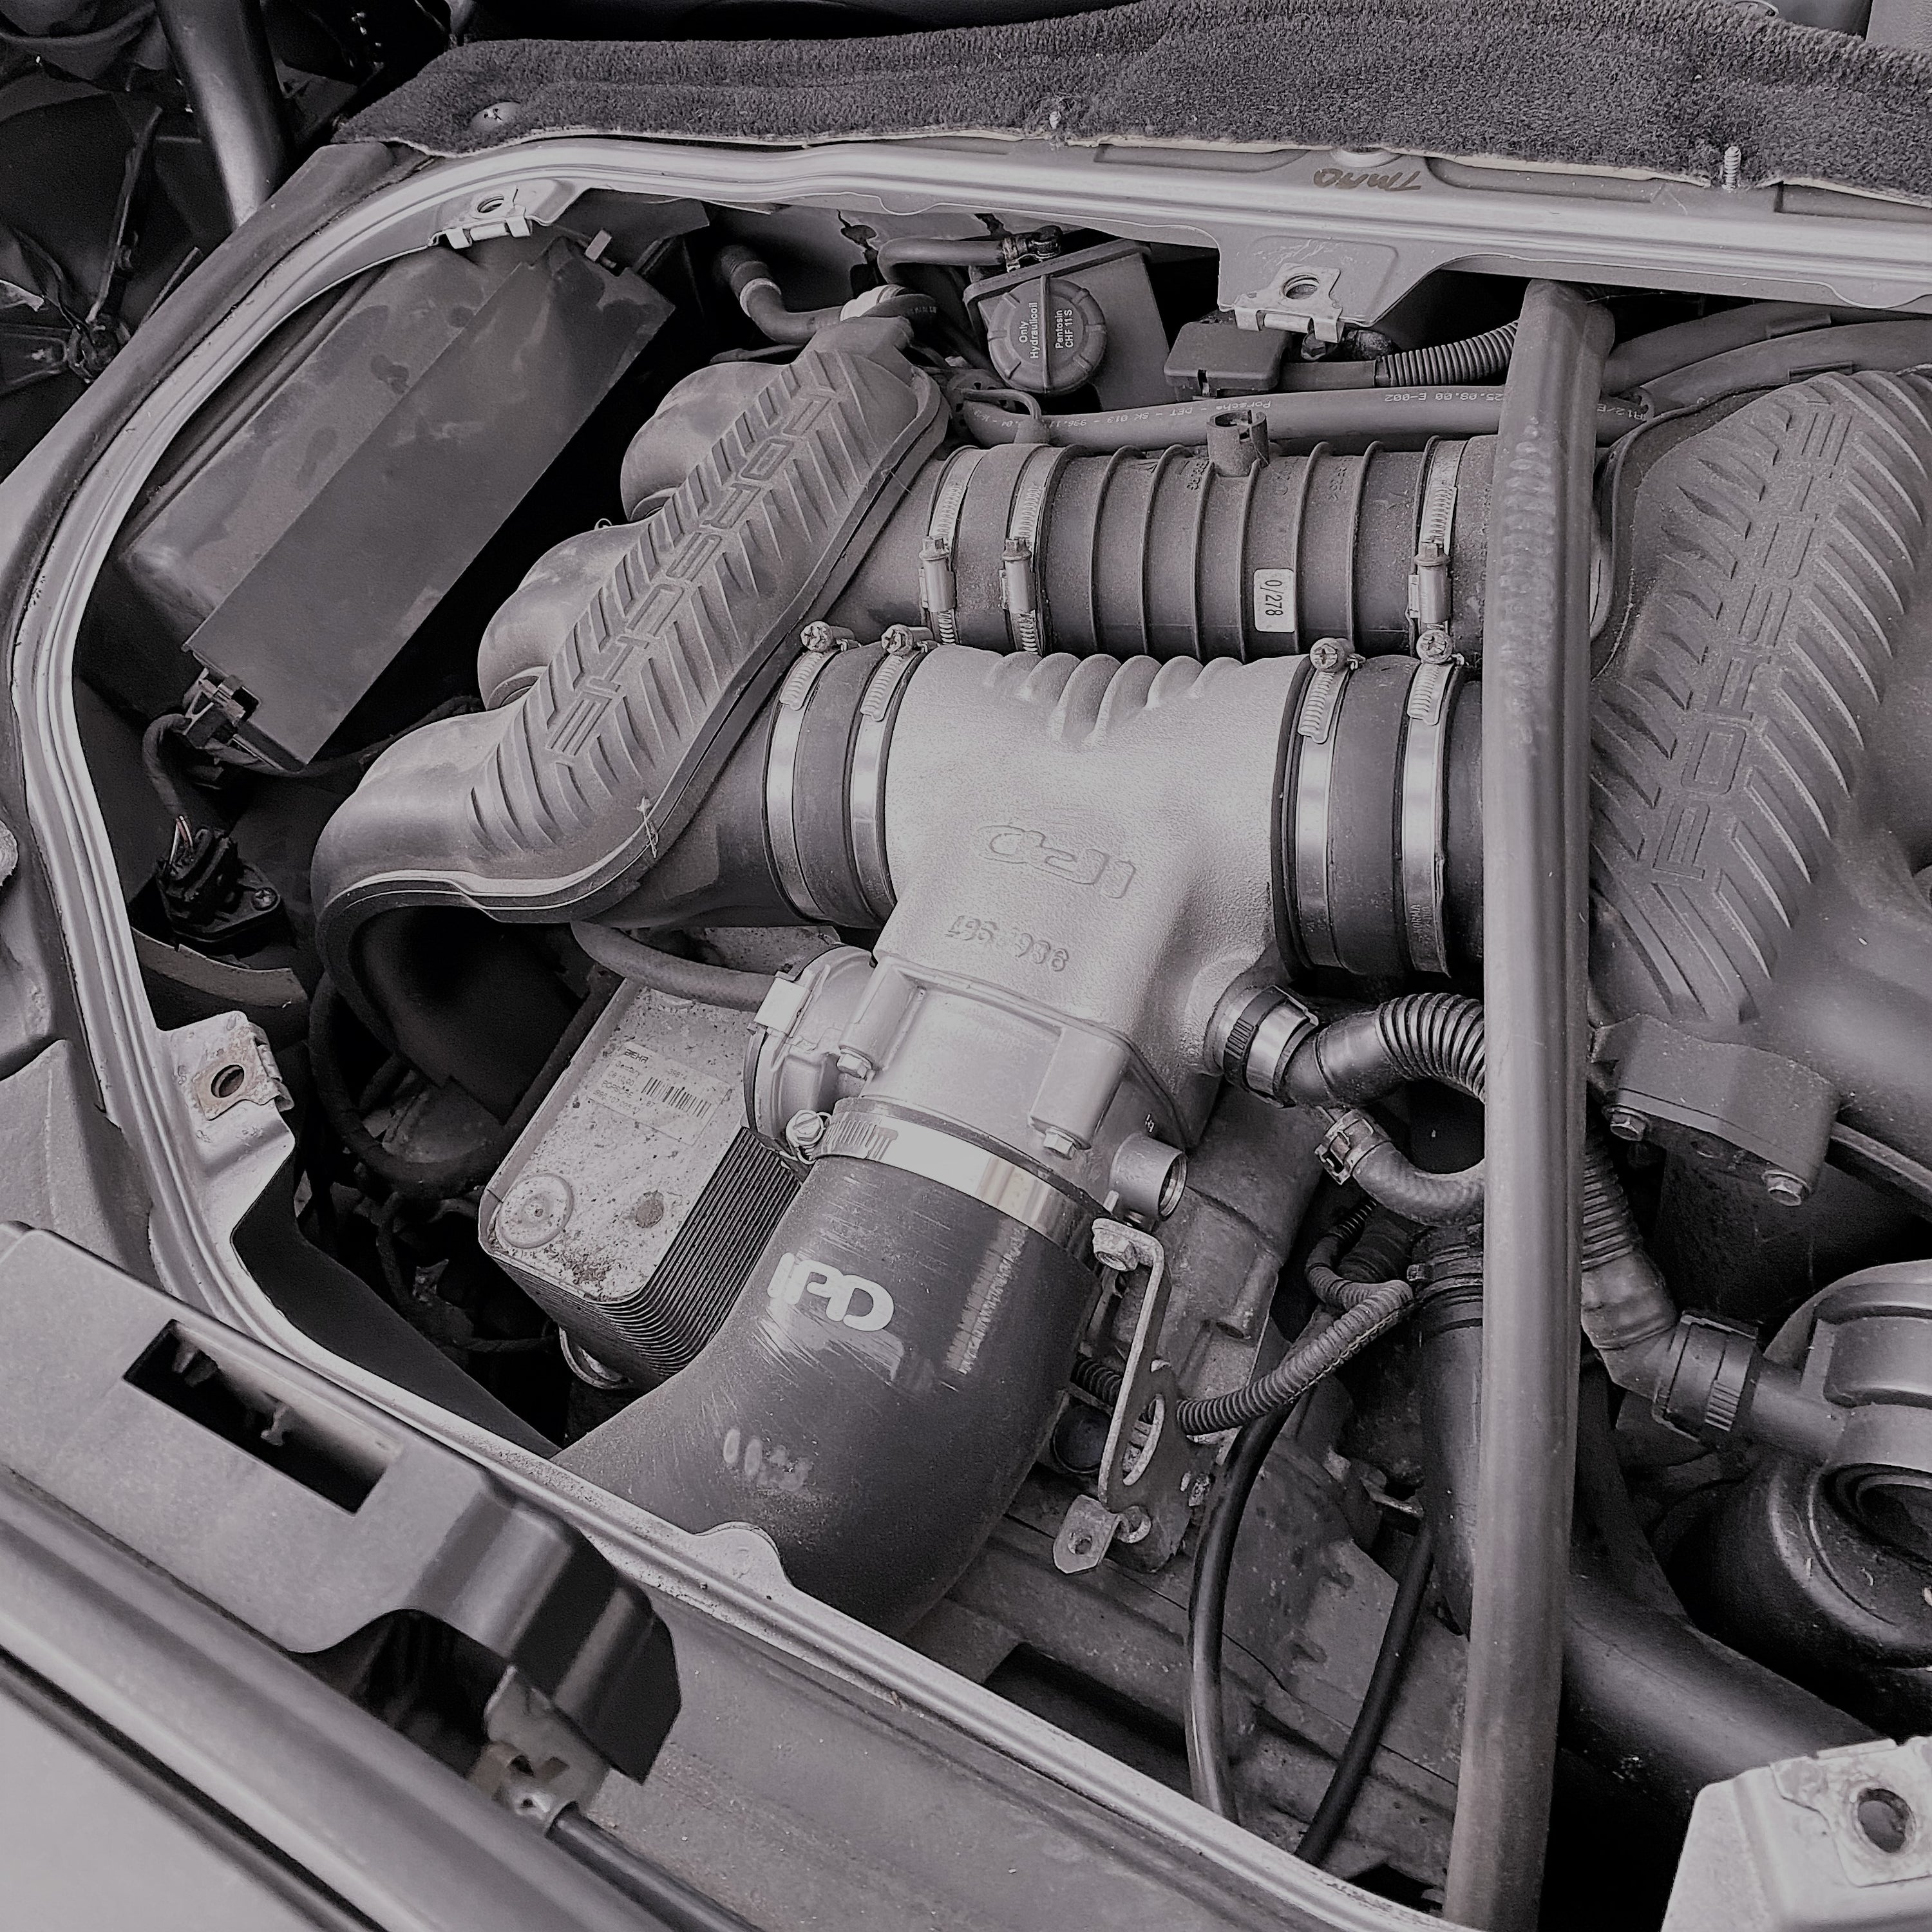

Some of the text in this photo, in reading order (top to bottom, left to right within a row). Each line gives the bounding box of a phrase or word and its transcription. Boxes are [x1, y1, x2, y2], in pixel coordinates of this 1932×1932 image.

[1019, 321, 1029, 343] Only
[1028, 302, 1040, 359] Hydraulicoil
[1055, 310, 1064, 349] Pentosin
[1065, 329, 1074, 348] CHF
[1134, 412, 1150, 421] SK
[1216, 399, 1271, 410] Porsche
[1265, 579, 1283, 616] 0/278
[766, 1253, 895, 1332] IPD
